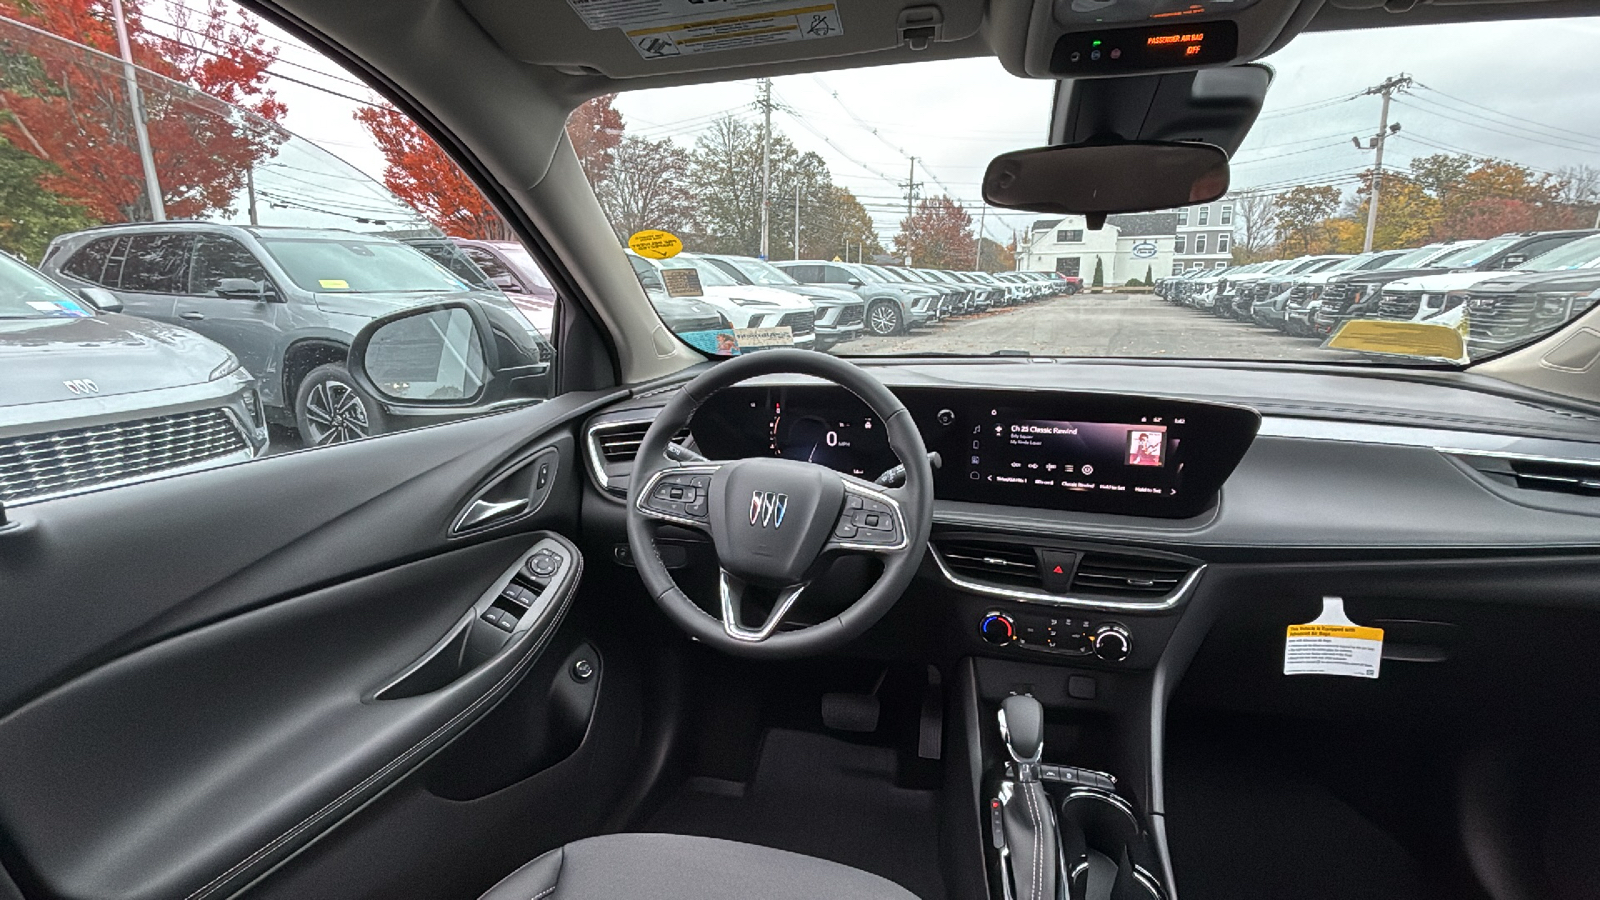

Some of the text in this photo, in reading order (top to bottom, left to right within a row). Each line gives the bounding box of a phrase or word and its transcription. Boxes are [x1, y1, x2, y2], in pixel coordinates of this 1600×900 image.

[1147, 35, 1180, 45] PASSENGER
[1191, 33, 1204, 41] BAG
[1186, 45, 1201, 54] OFF
[1030, 426, 1052, 434] Classic
[1053, 427, 1078, 435] Rewind
[826, 431, 838, 447] 0
